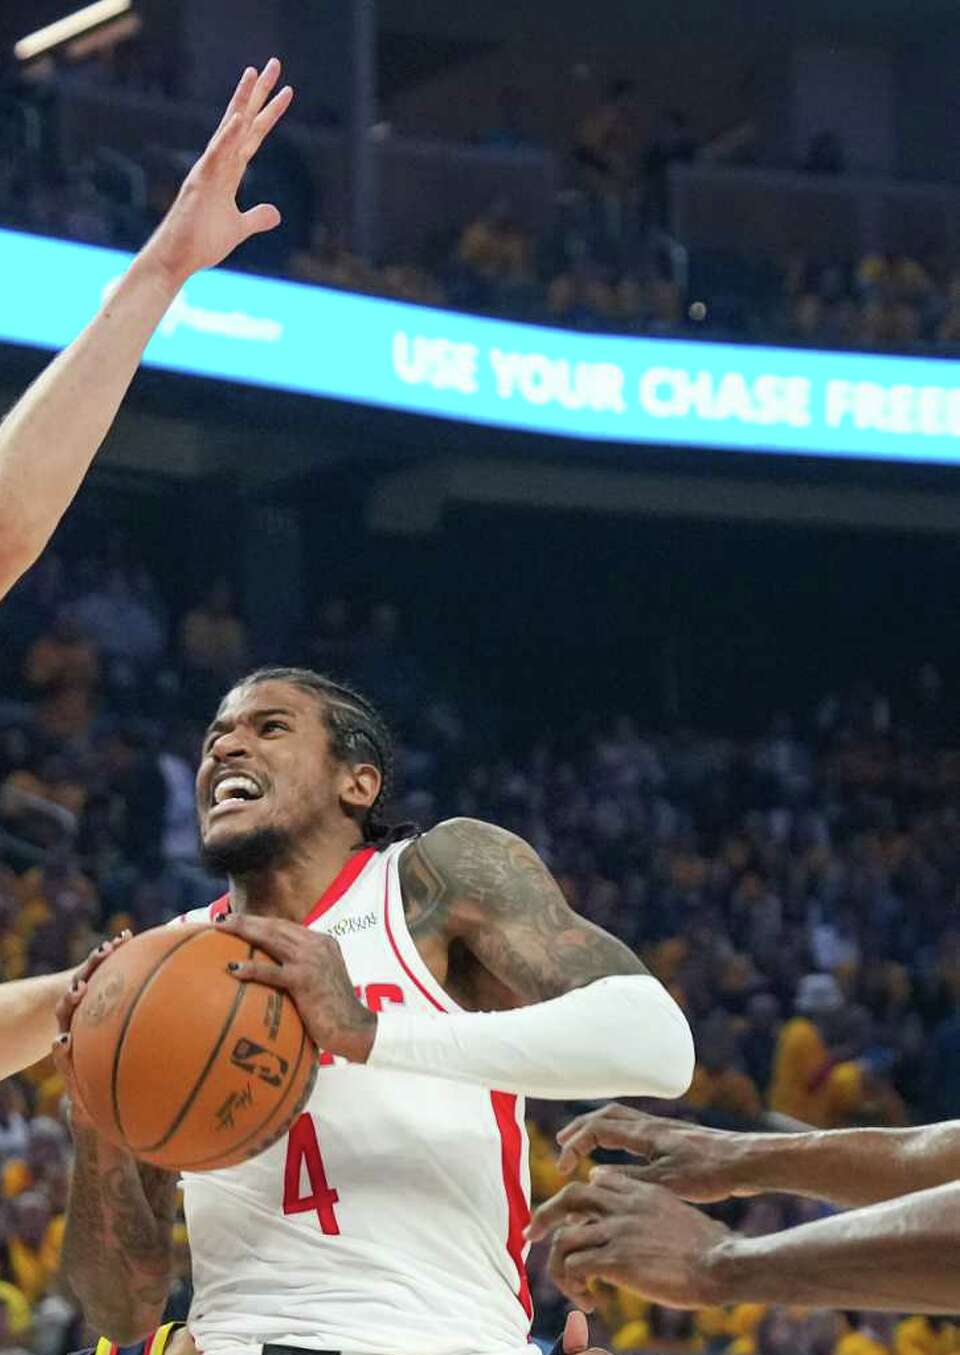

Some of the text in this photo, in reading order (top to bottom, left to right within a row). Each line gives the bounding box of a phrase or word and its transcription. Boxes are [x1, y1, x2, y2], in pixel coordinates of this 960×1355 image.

[392, 331, 477, 393] USE
[489, 347, 626, 414] YOUR
[639, 367, 811, 427] CHASE
[283, 1112, 340, 1236] 4
